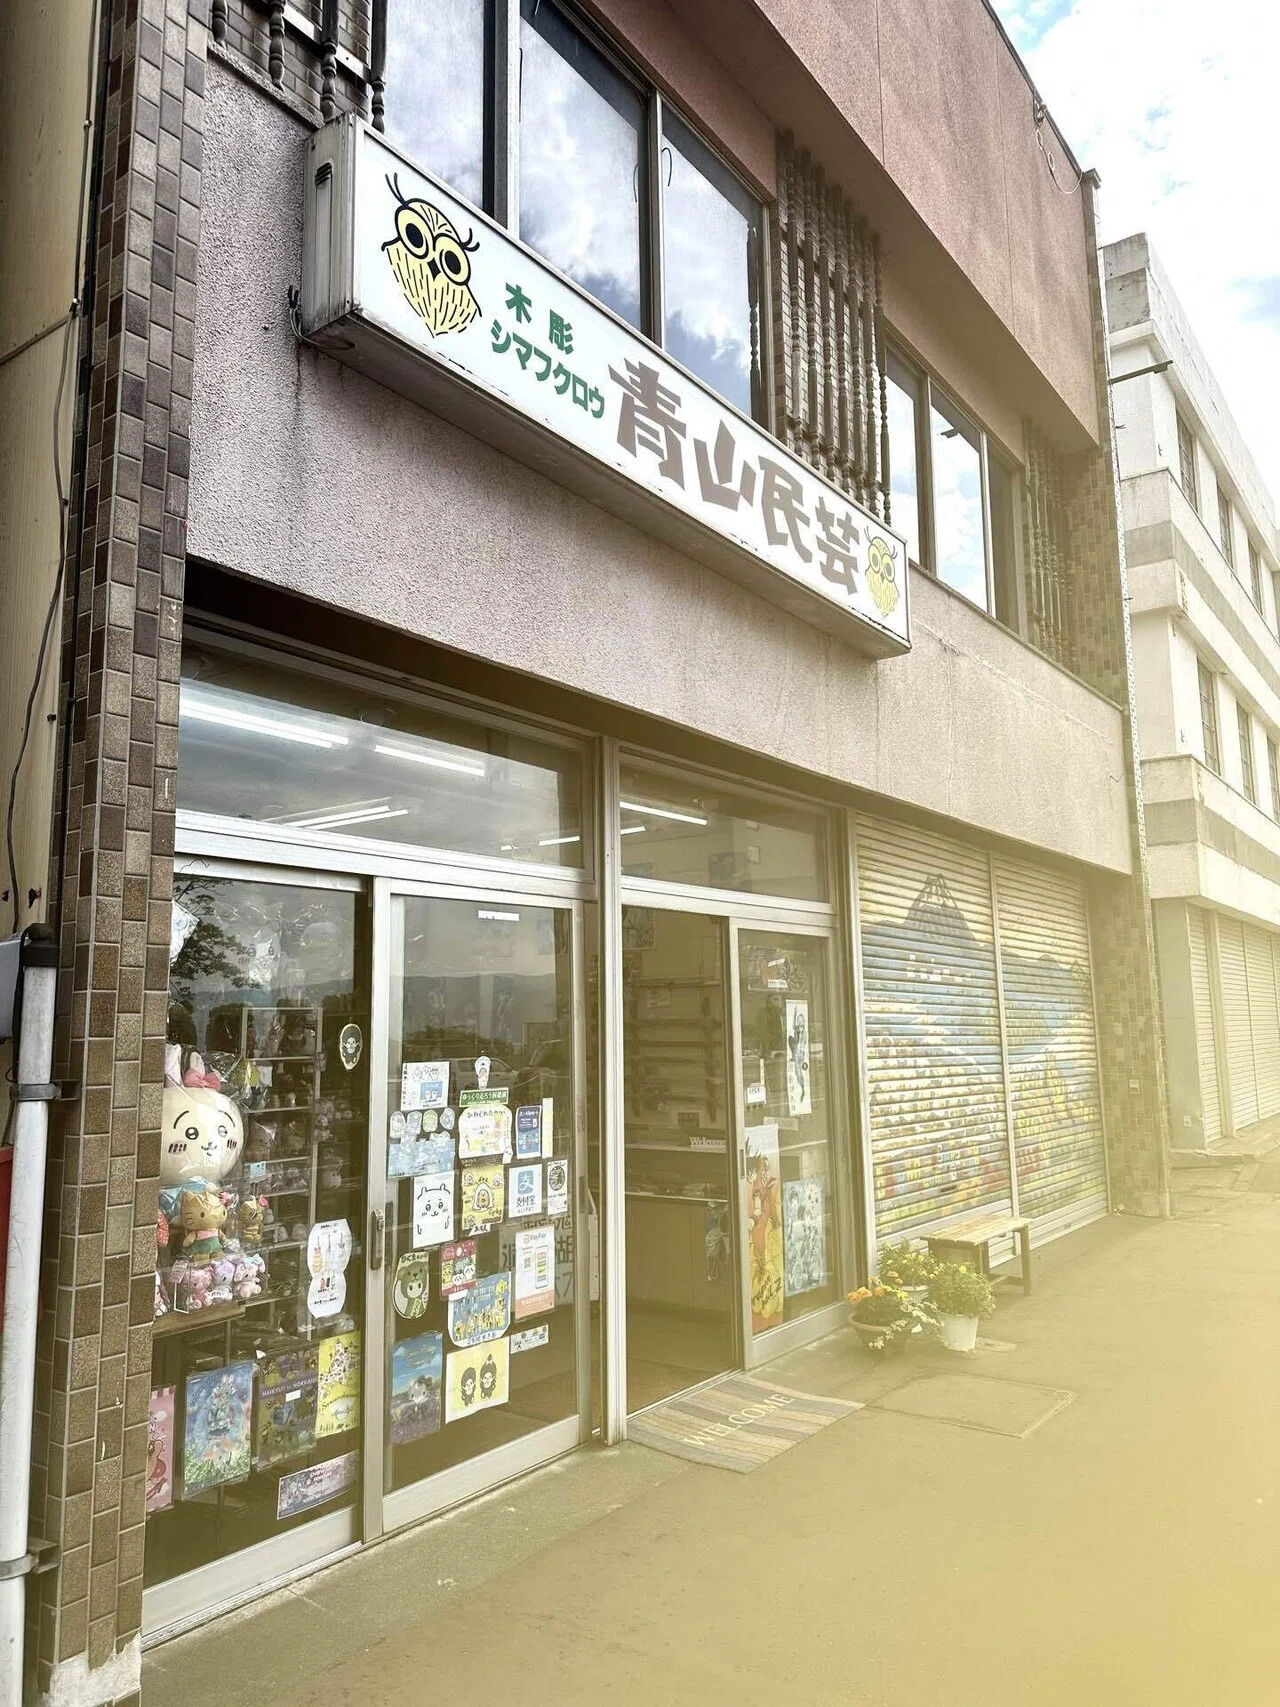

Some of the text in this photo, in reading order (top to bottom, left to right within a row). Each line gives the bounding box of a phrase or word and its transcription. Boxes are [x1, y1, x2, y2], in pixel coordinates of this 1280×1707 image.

[504, 282, 575, 356] 木彫
[490, 318, 606, 420] シマフクロウ
[607, 357, 862, 597] 青山民芸
[682, 1392, 796, 1447] WELCOME
